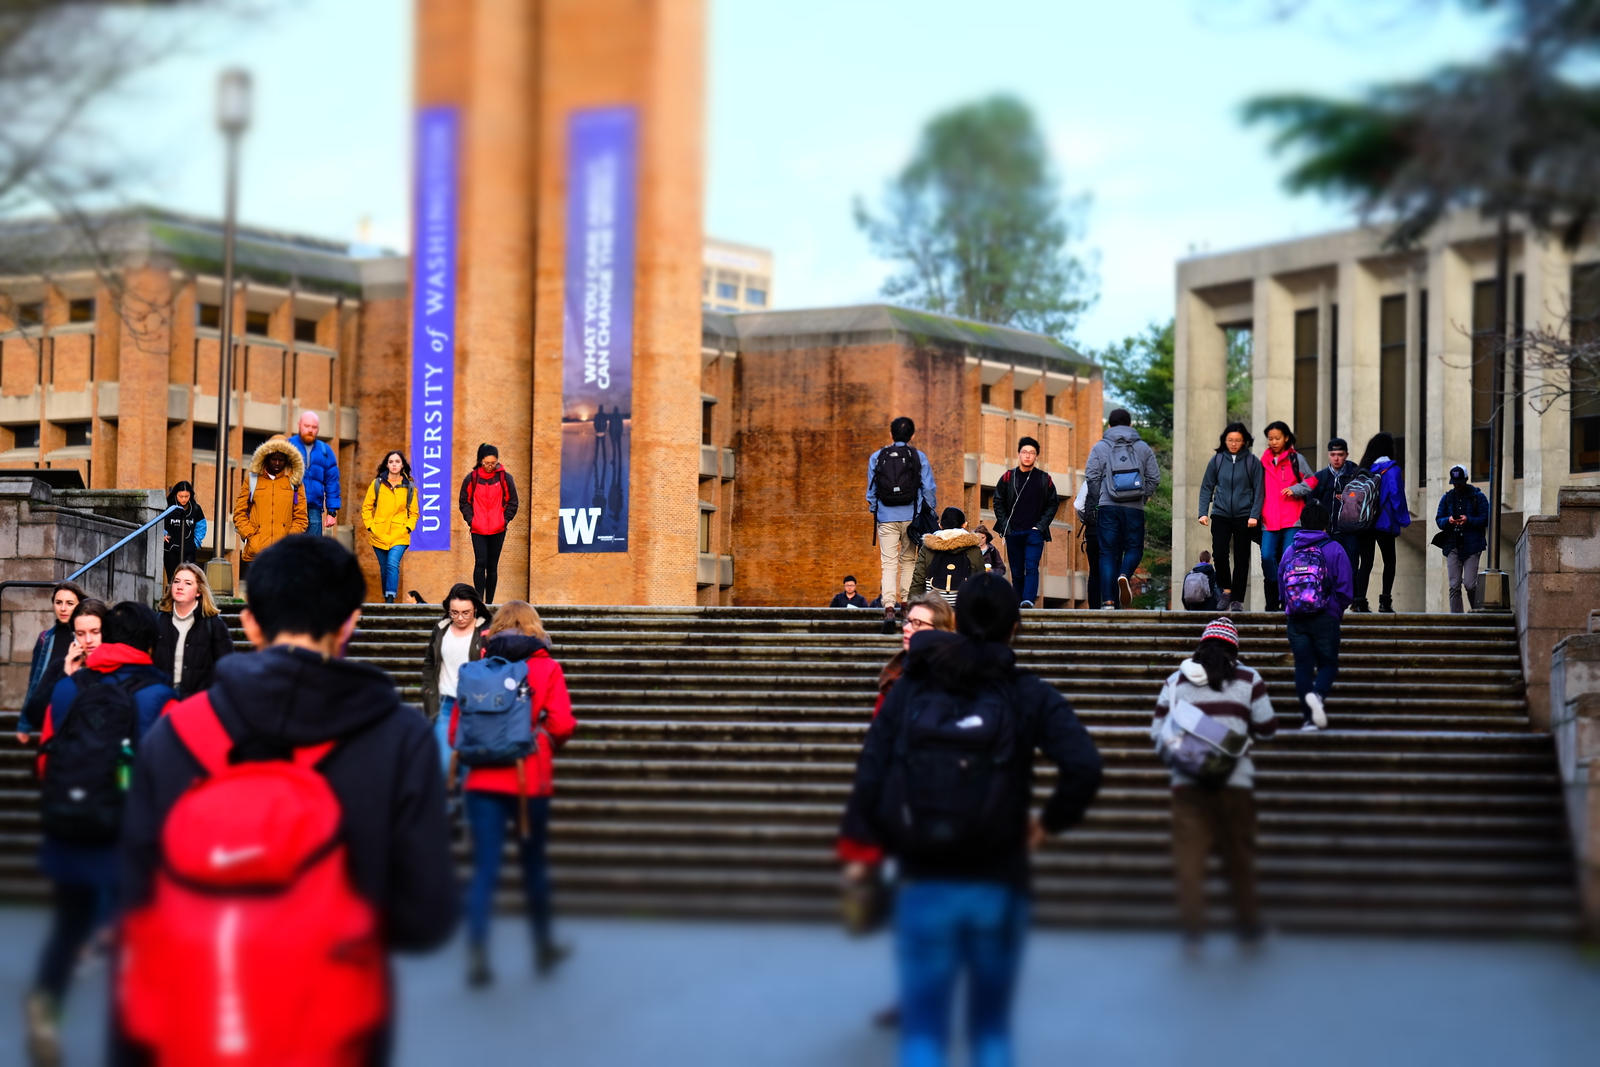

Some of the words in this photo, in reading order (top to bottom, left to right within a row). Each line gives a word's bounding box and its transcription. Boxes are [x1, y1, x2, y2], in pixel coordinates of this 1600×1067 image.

[426, 123, 447, 316] WASHIN
[584, 281, 598, 323] YOU
[598, 270, 613, 347] CHANGE
[425, 325, 448, 352] of
[584, 324, 597, 384] WHAT
[597, 349, 610, 389] CAN
[422, 363, 443, 532] UNIVERSITY
[558, 507, 602, 545] W
